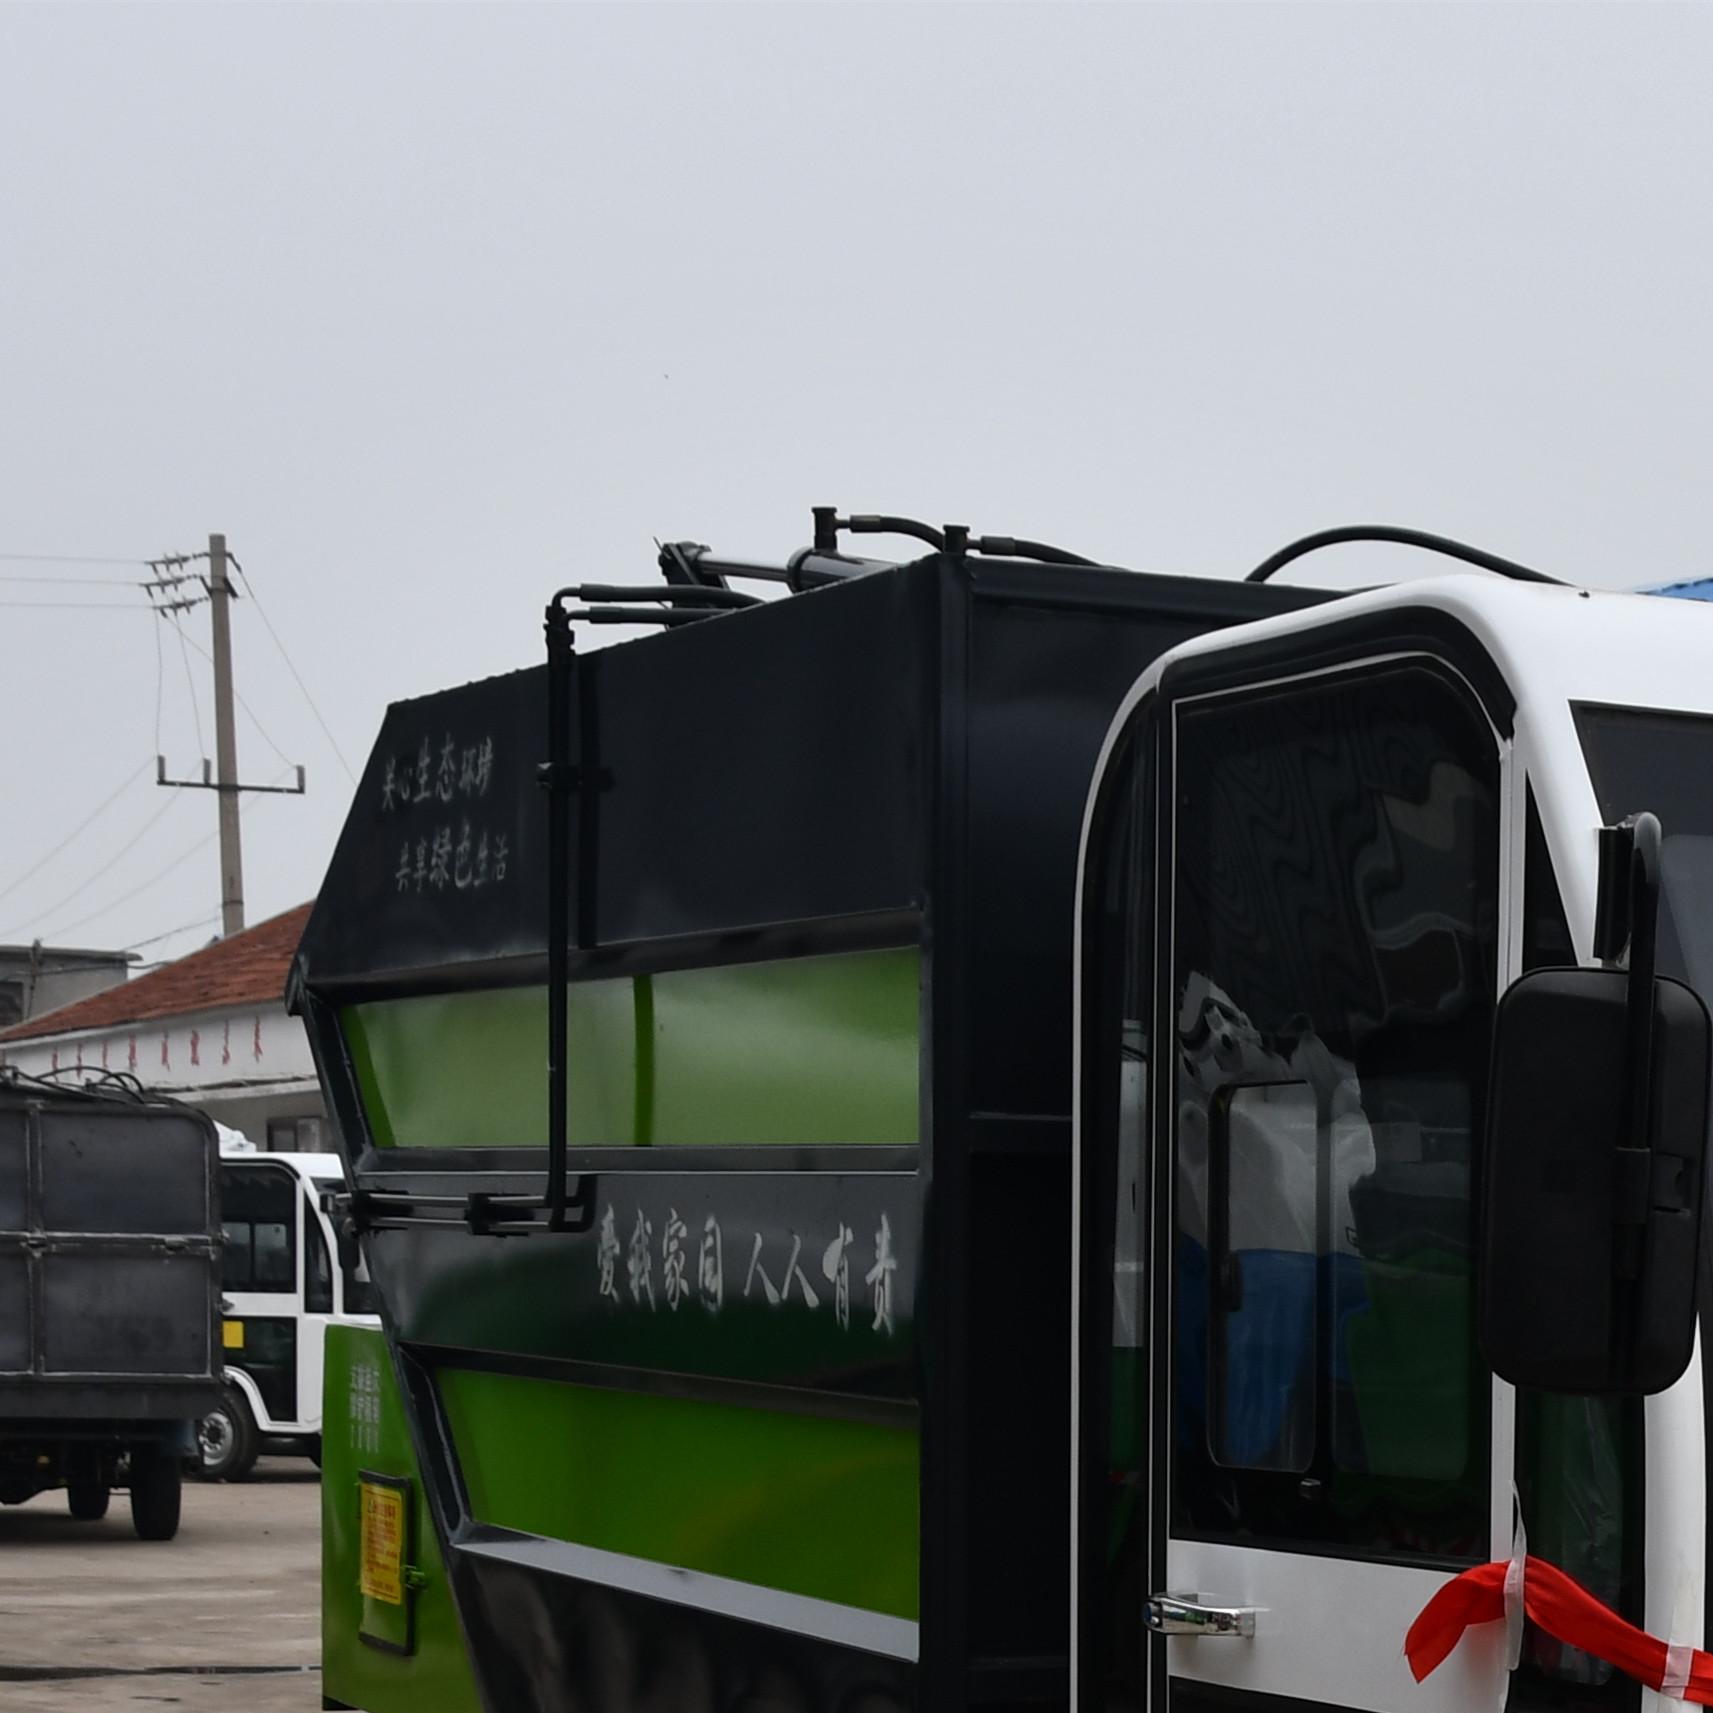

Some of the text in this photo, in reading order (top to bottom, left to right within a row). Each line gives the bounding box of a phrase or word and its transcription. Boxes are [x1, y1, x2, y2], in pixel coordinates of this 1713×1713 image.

[382, 731, 493, 811] 关心生态环境
[395, 817, 510, 893] 共享绿色生活
